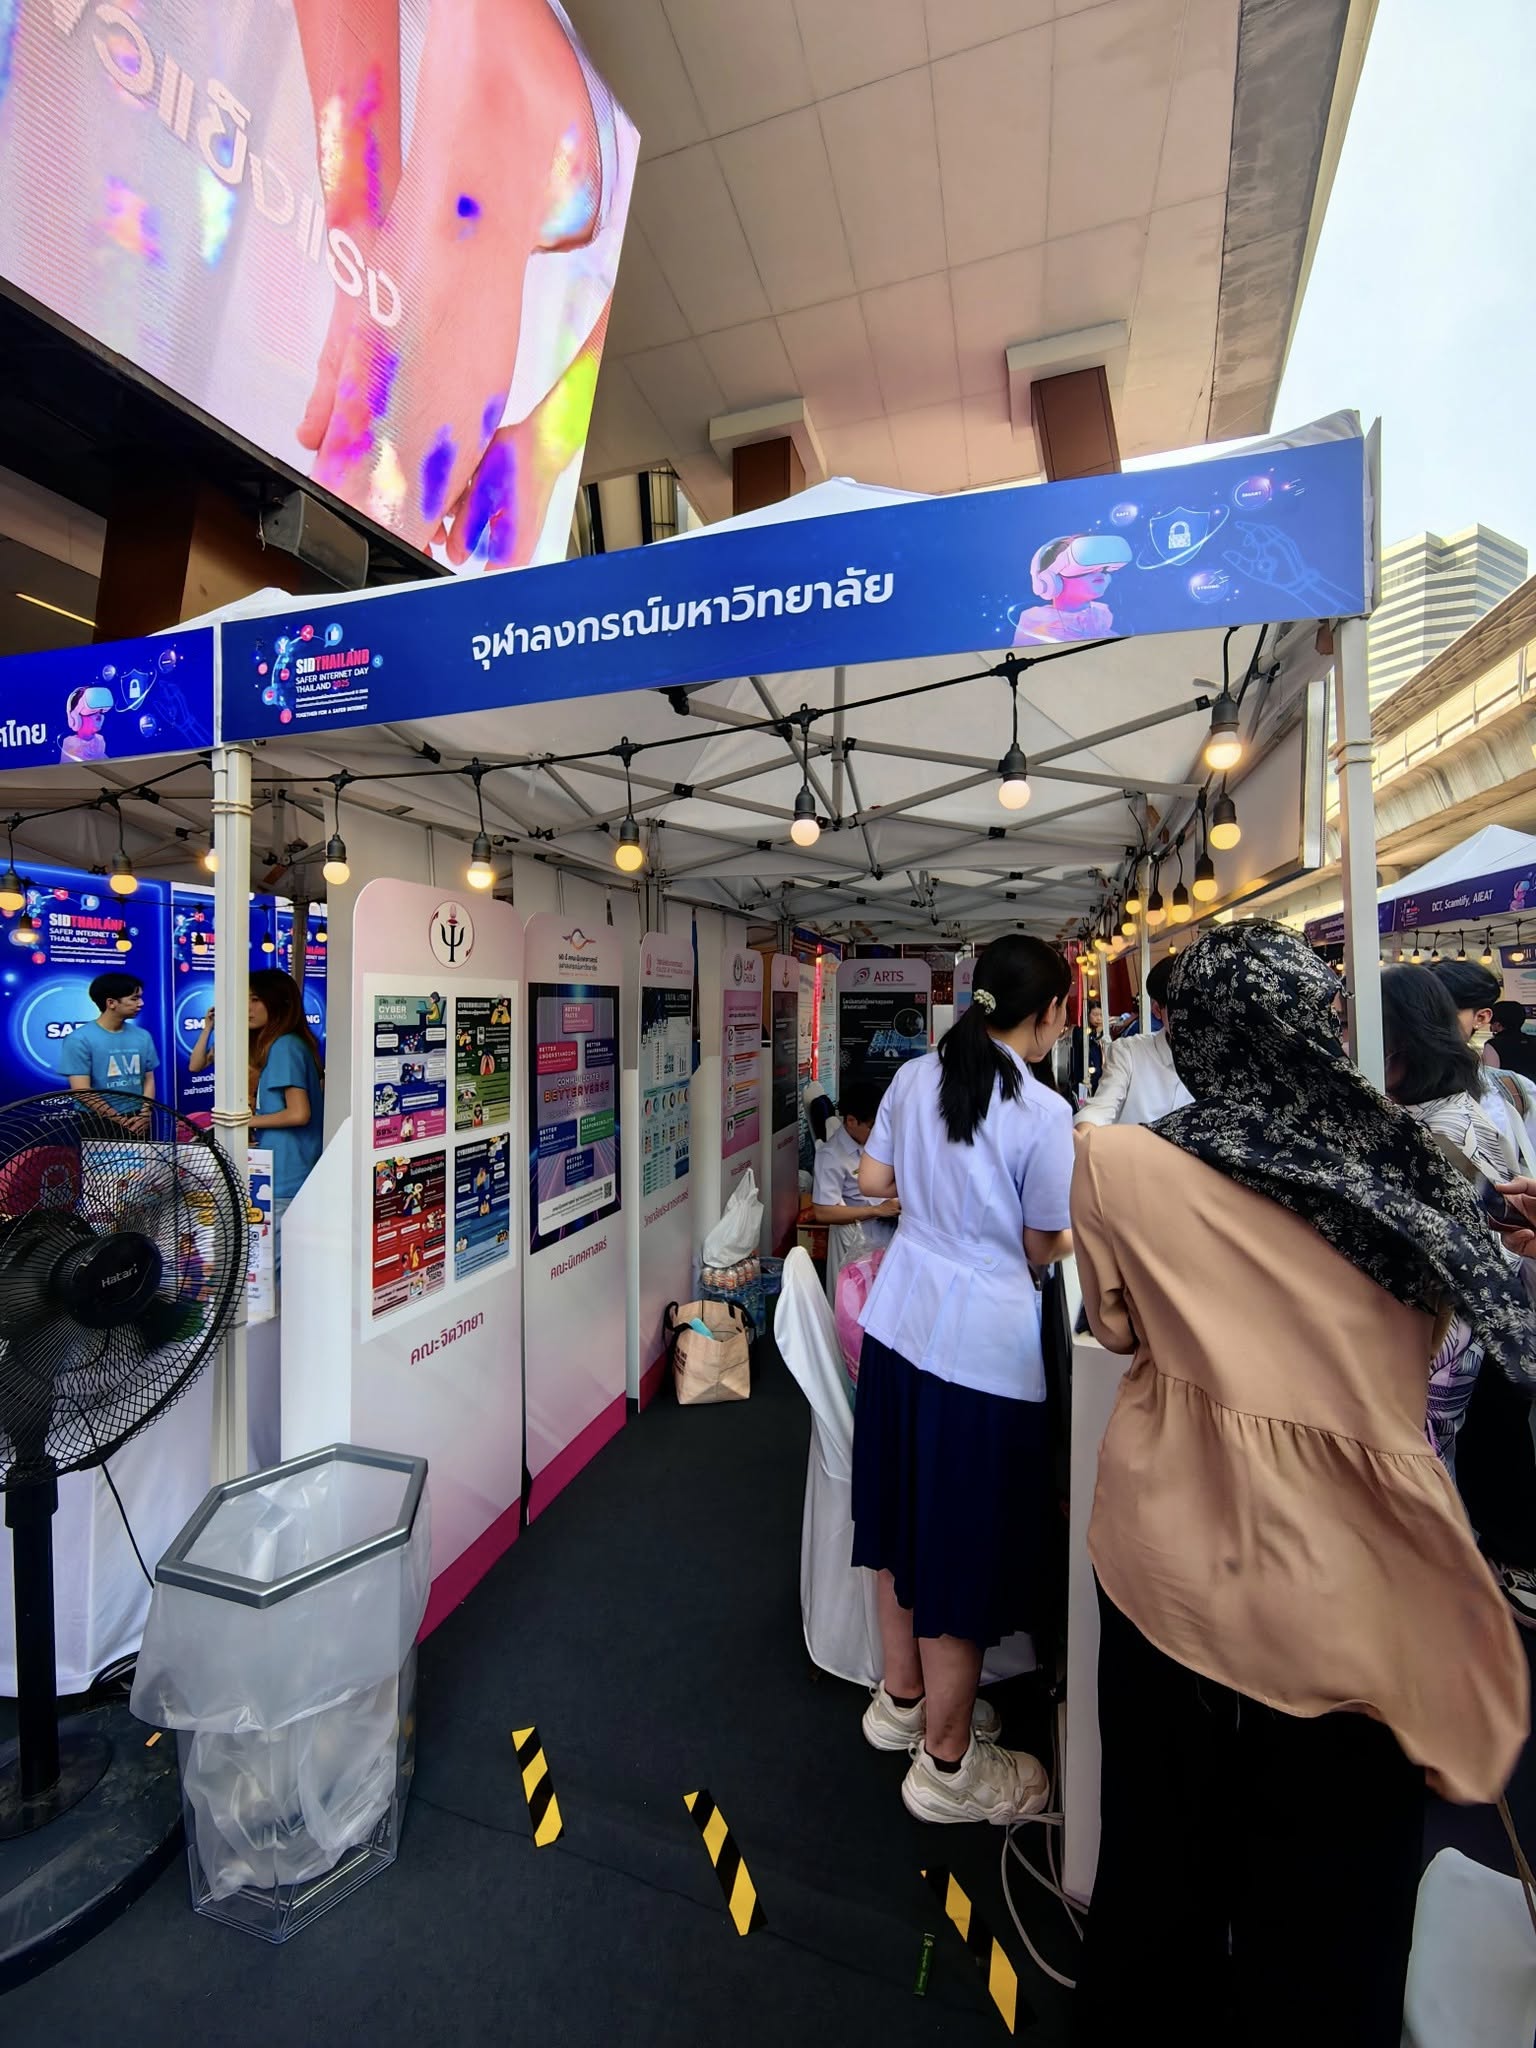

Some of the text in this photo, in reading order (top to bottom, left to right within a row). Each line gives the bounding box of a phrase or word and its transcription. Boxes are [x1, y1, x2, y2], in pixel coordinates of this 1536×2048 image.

[471, 566, 895, 671] จุฬาลงกรณ์มหาวิทยาลัย
[296, 667, 369, 684] SAFER INTERNET DAY
[296, 680, 349, 692] THAILAND 2025
[1472, 889, 1494, 904] AIEAT
[49, 927, 110, 939] SAFER INTERNET
[49, 934, 88, 944] THAILAND
[873, 970, 904, 983] ARTS
[378, 1005, 407, 1014] CYBER
[47, 1022, 85, 1039] SA
[543, 1080, 610, 1104] BETTERVERSE
[539, 1126, 558, 1135] BETTER
[550, 1235, 607, 1280] คณะนิเทศศาสตร์
[101, 1263, 138, 1288] Hatari
[410, 1311, 485, 1366] คณะจิตวิทยา
